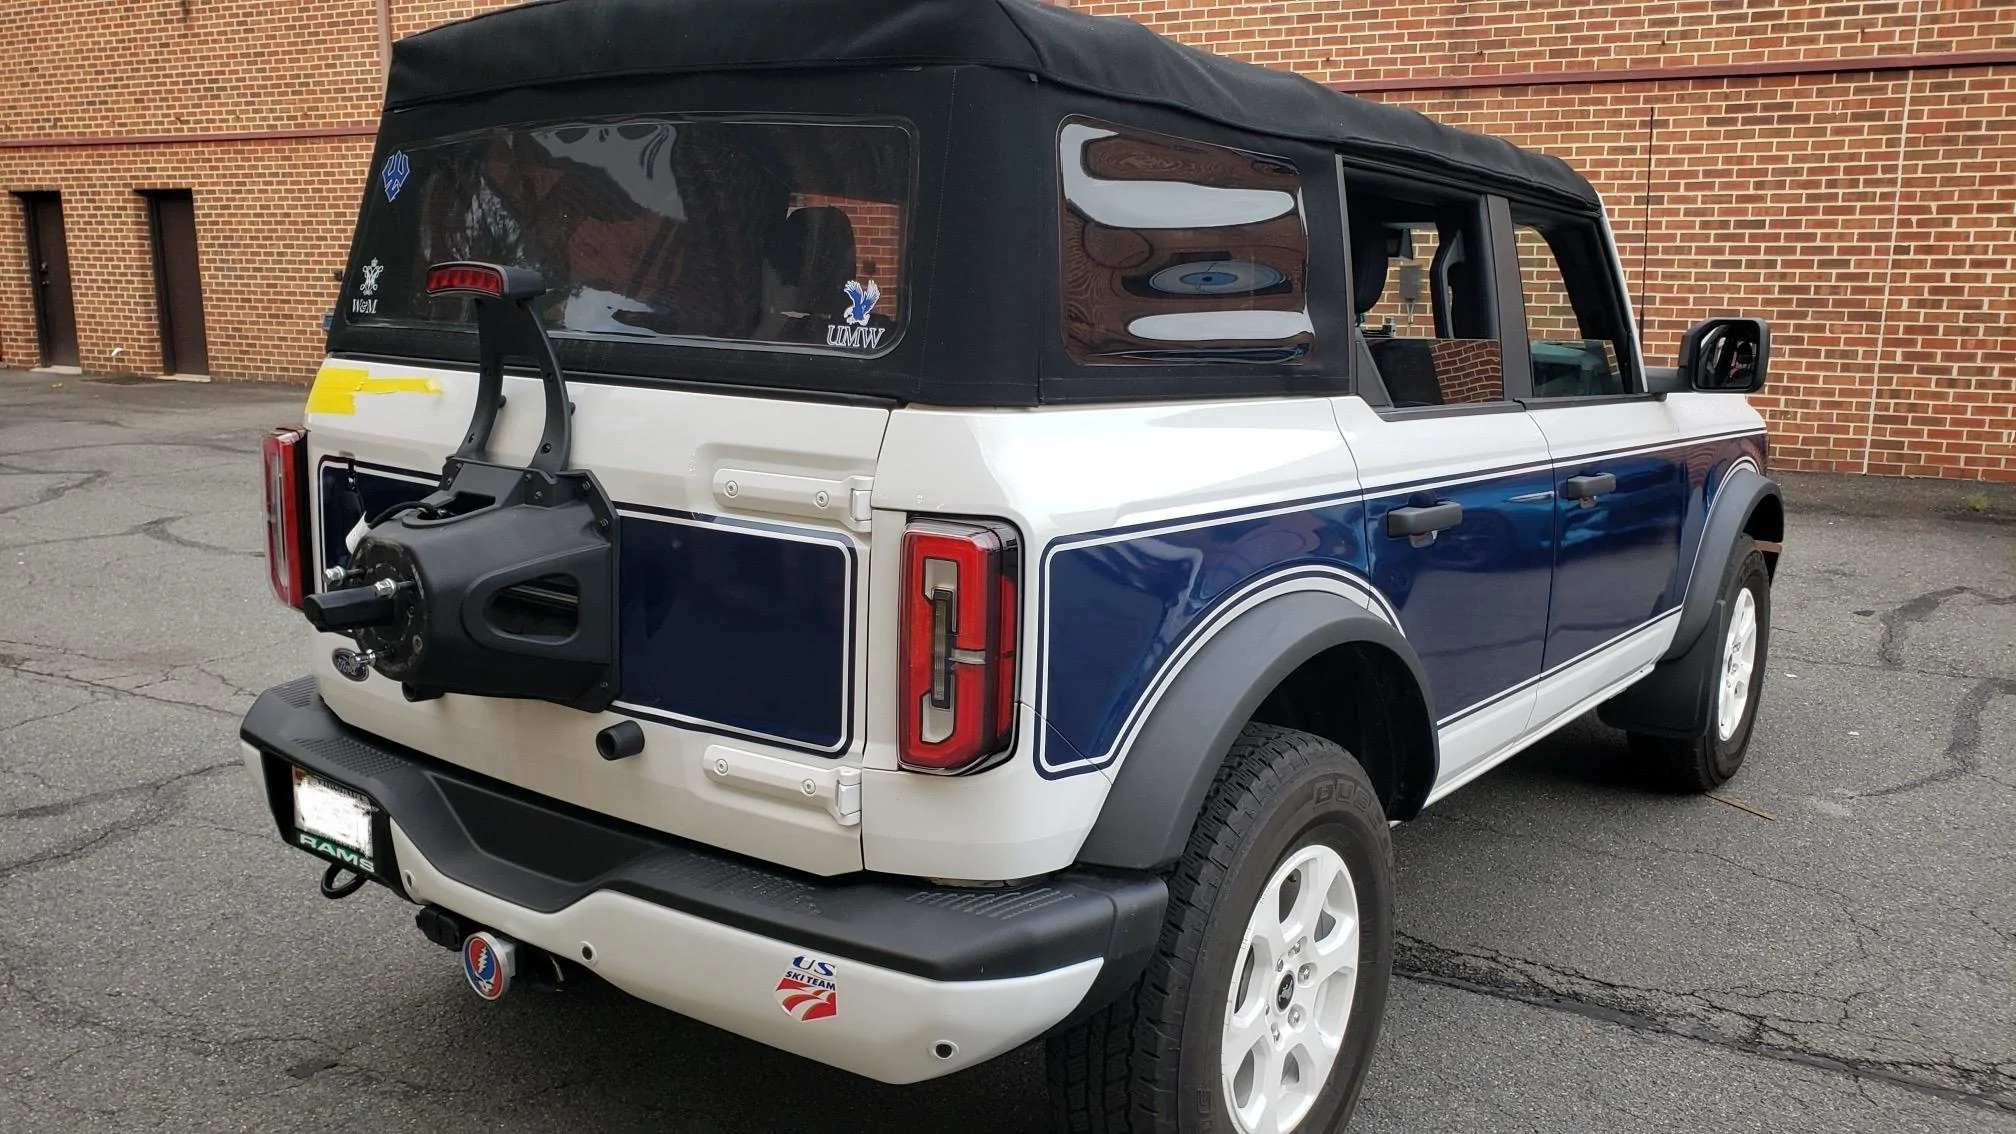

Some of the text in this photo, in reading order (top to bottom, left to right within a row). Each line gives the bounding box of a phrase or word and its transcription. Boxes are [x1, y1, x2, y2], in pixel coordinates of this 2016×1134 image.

[352, 298, 378, 314] W&M
[826, 324, 886, 349] UMW
[300, 833, 375, 873] RAMS
[792, 955, 836, 977] US
[785, 970, 836, 991] SKI TEAM
